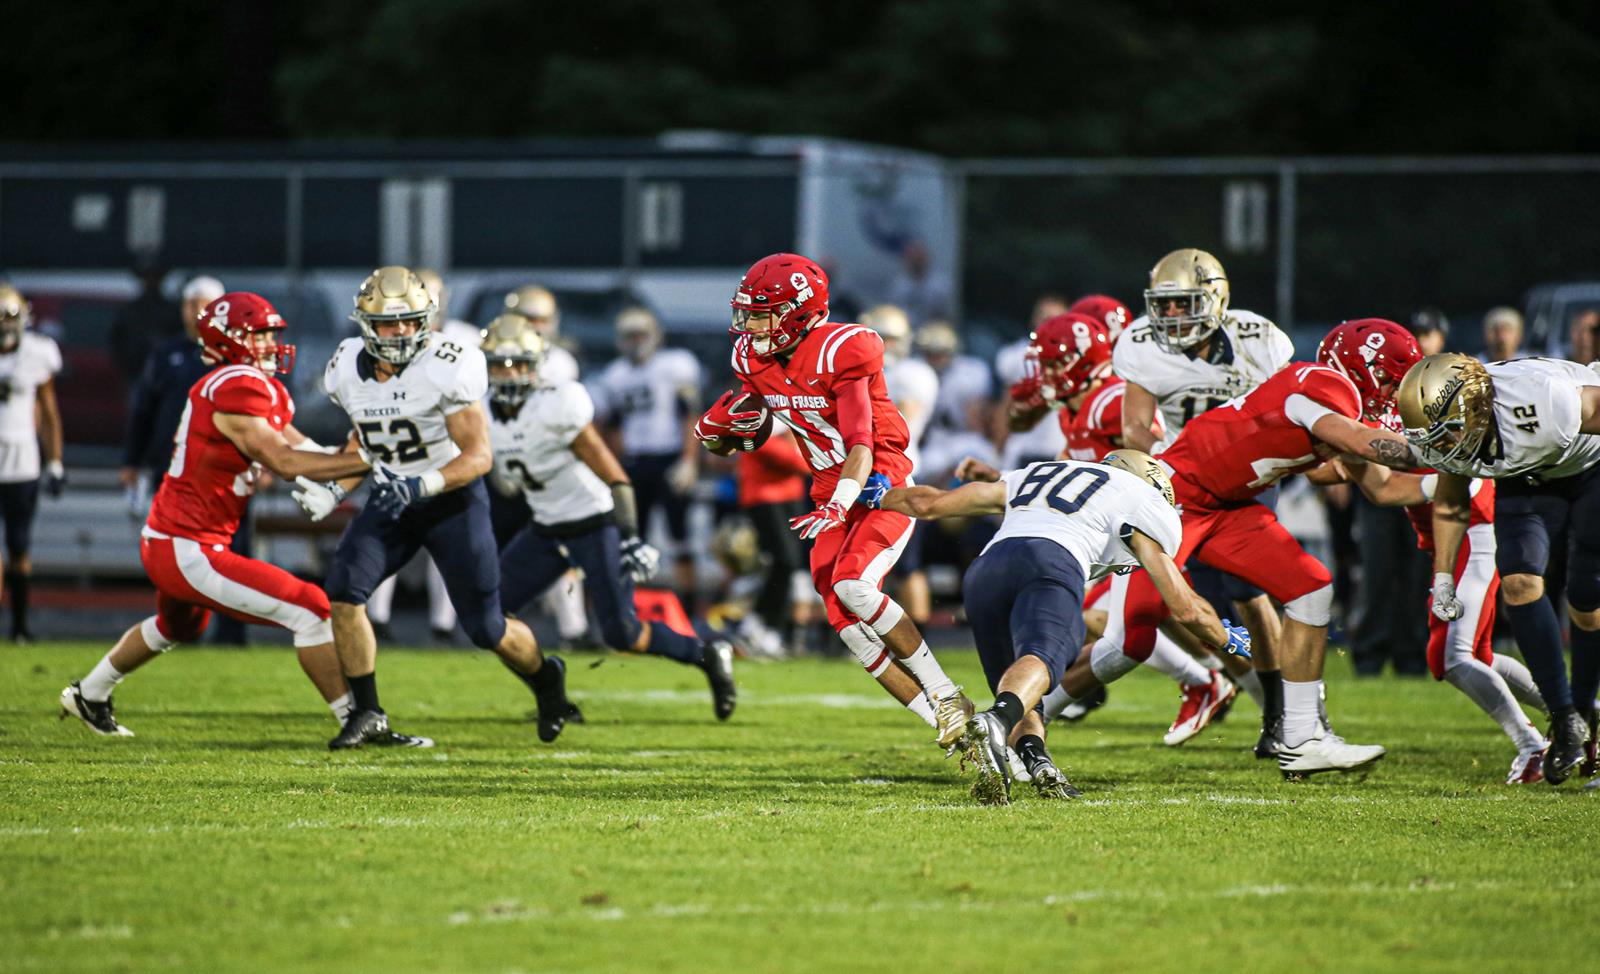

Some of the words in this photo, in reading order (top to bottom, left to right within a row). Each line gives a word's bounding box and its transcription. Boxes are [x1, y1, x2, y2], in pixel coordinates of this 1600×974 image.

[1237, 322, 1261, 339] 15
[435, 341, 463, 363] 52
[791, 396, 829, 409] FRASER
[1514, 403, 1540, 434] 42
[358, 419, 430, 464] 52
[1009, 462, 1111, 516] 80
